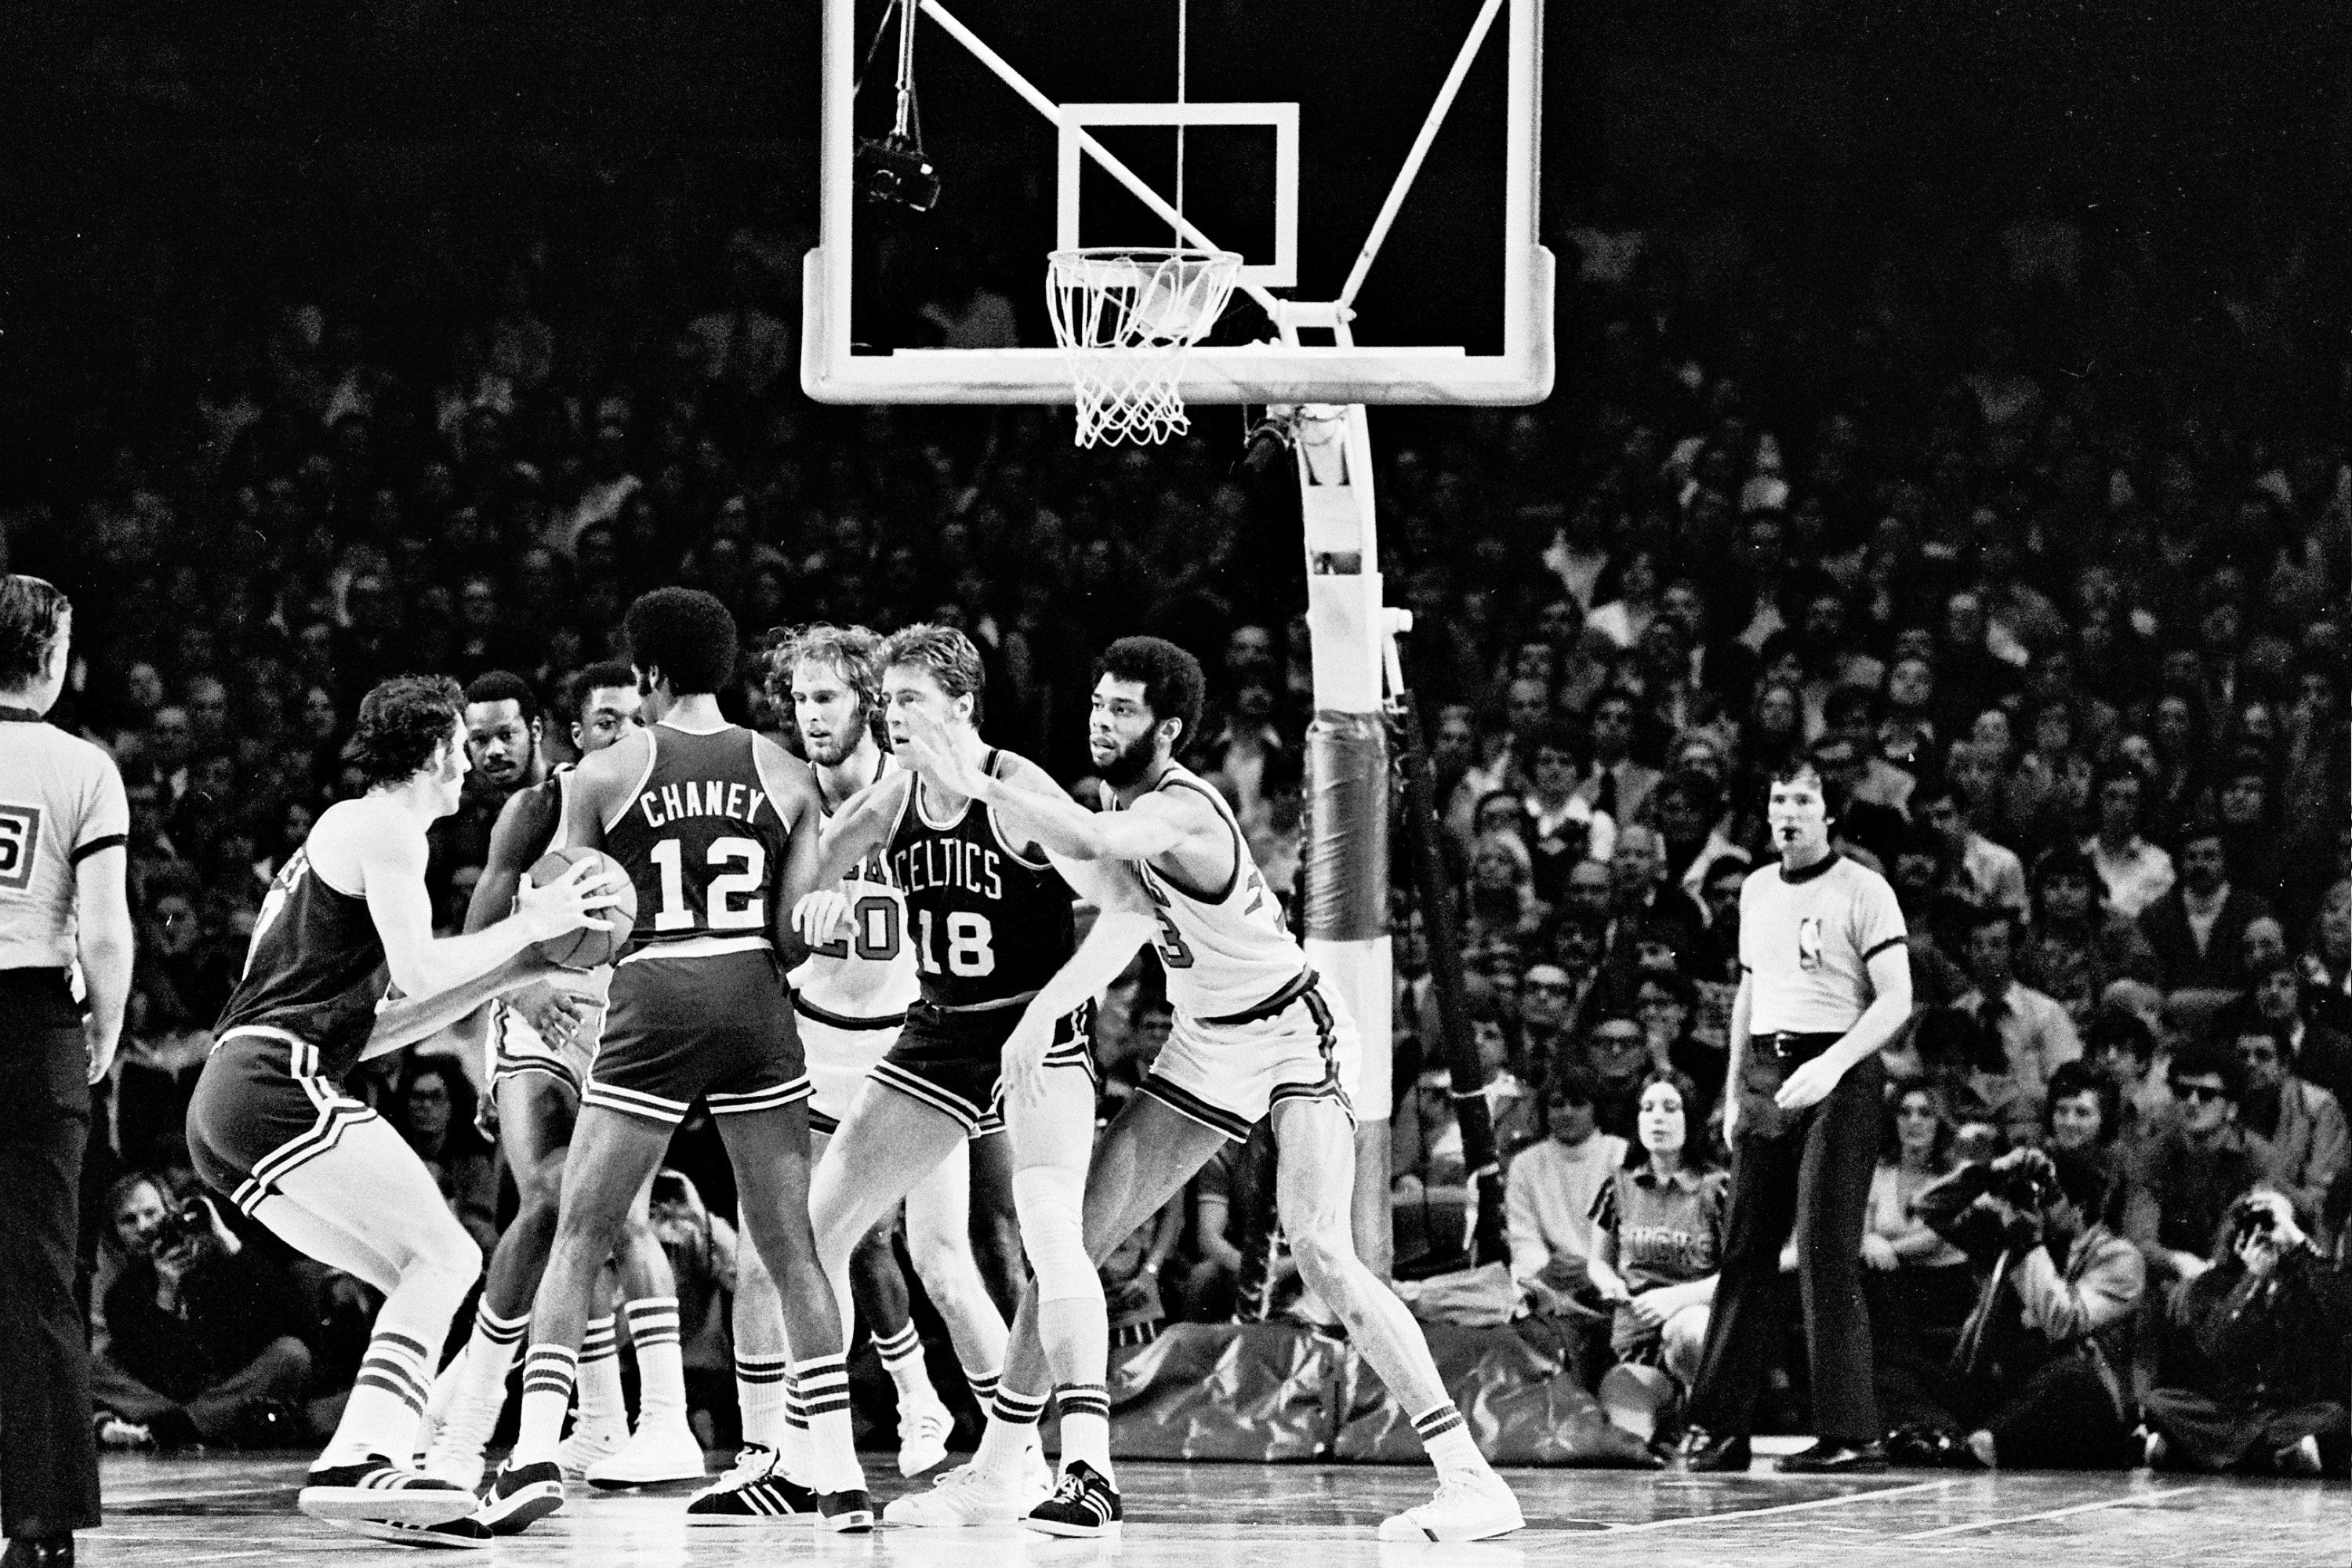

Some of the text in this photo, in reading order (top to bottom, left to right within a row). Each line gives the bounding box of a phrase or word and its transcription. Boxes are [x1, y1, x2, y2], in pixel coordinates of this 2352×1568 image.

[640, 781, 765, 827] CHANEY
[651, 837, 765, 931] 12
[895, 838, 1002, 900] CELTICS
[811, 896, 899, 960] 0
[919, 909, 996, 977] 18
[1620, 1226, 1715, 1269] UCKS
